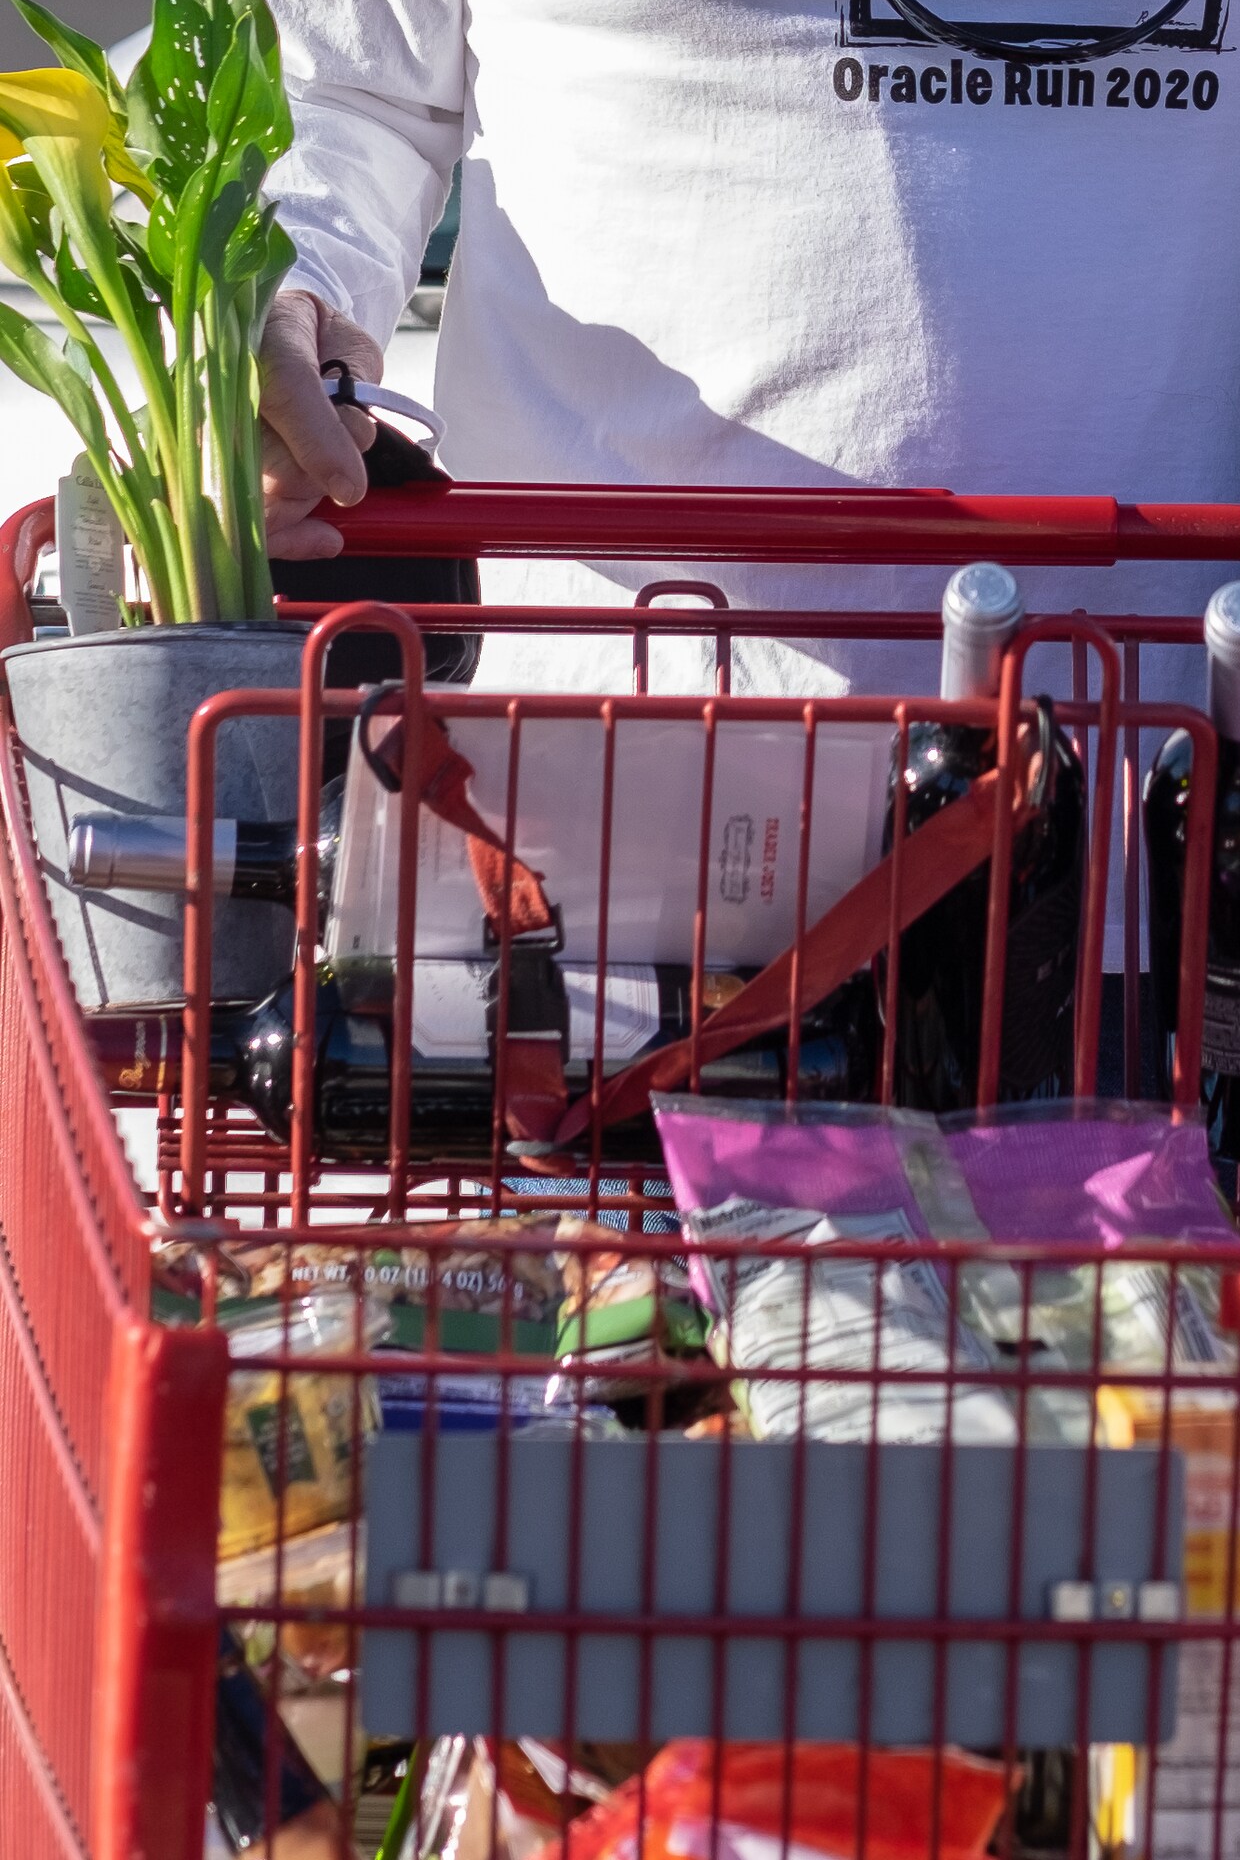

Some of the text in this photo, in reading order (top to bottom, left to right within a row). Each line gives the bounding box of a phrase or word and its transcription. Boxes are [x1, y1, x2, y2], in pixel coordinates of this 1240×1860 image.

[832, 57, 1220, 111] Oracle Run 2020
